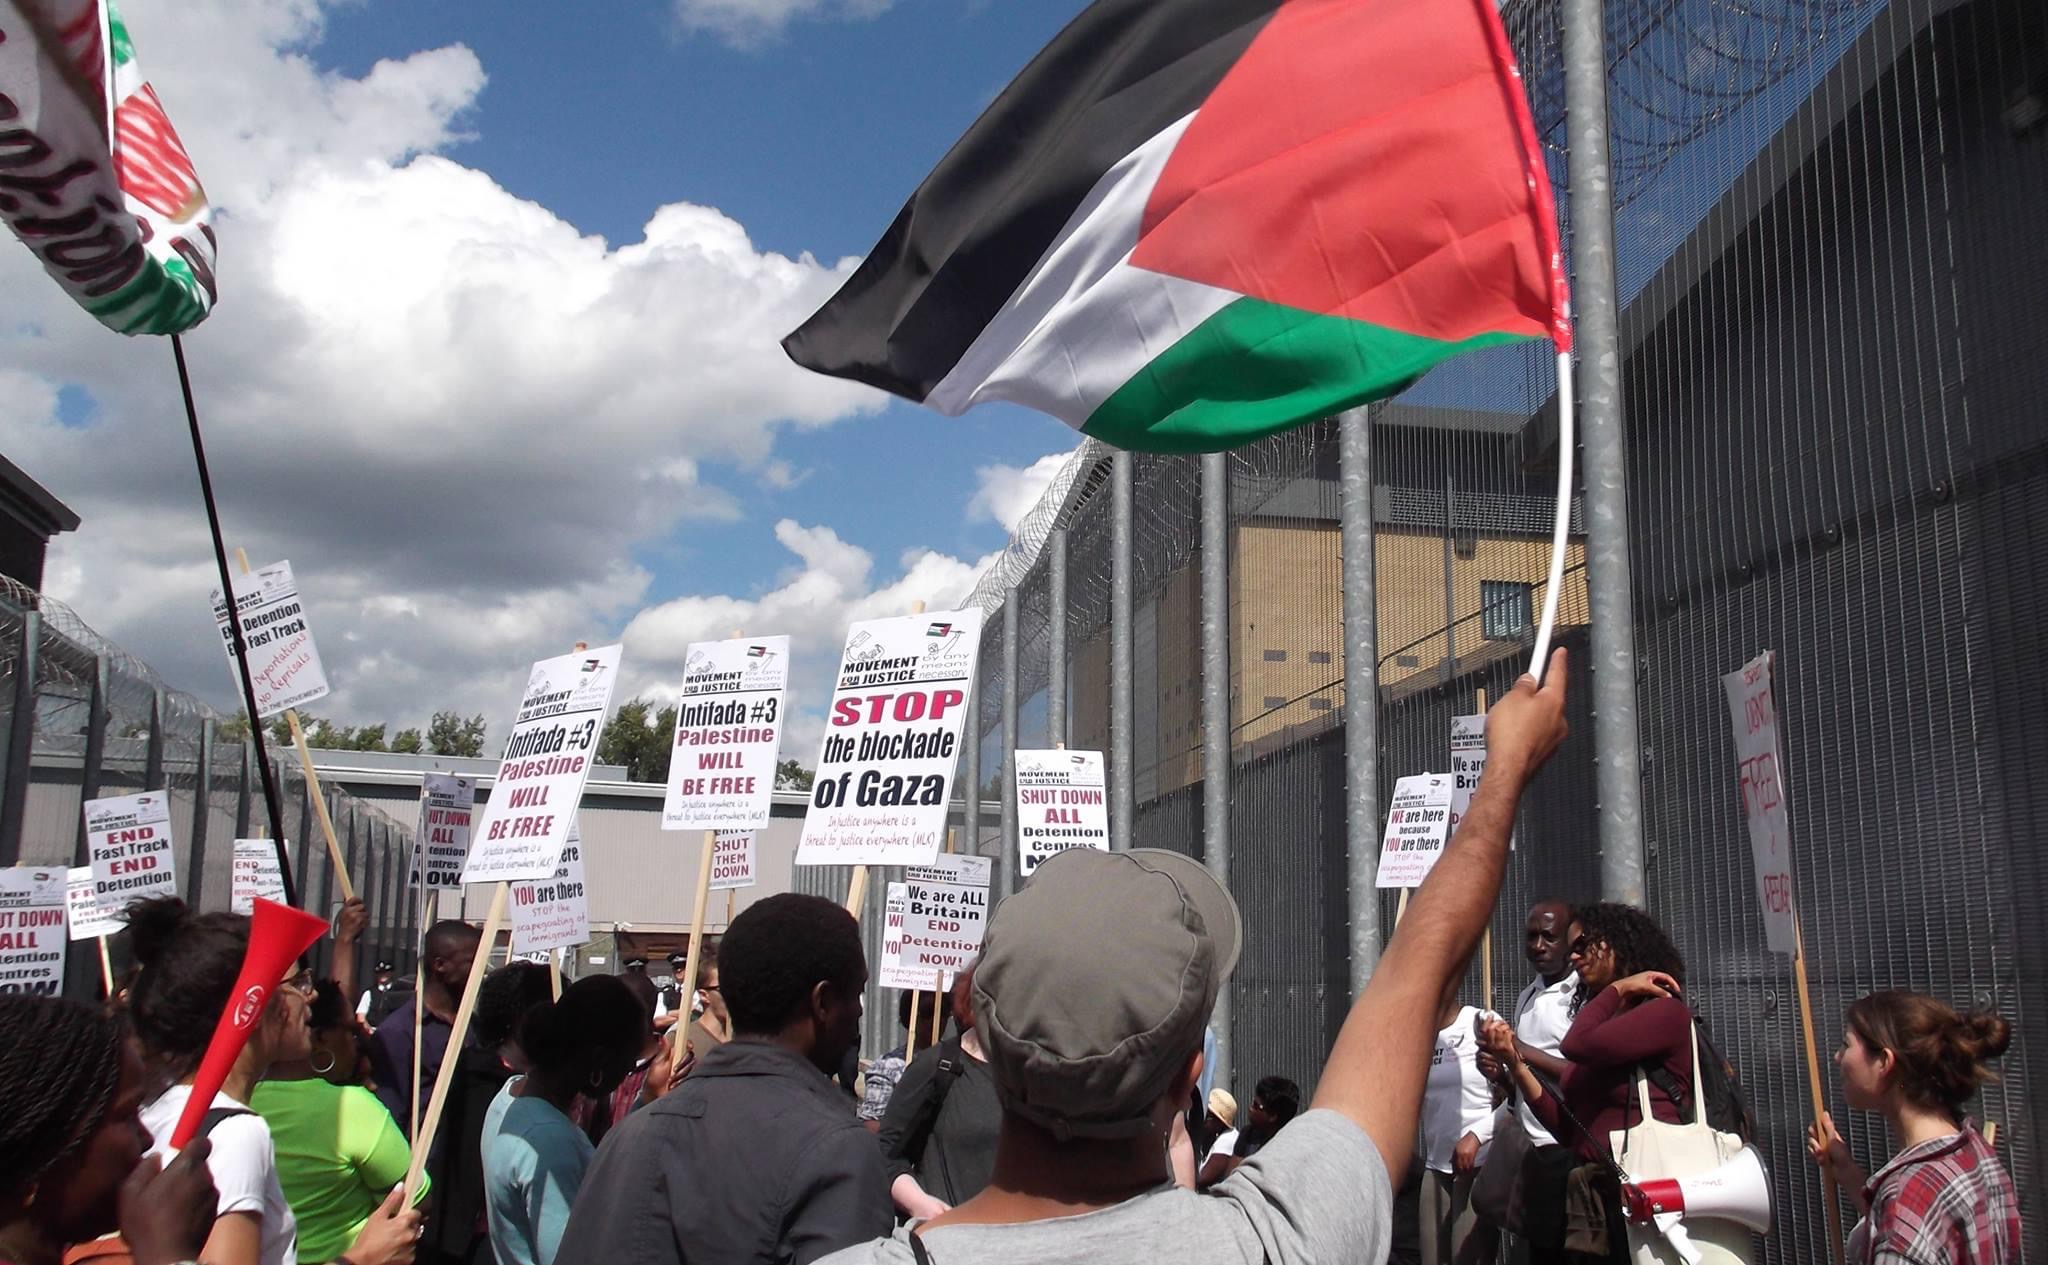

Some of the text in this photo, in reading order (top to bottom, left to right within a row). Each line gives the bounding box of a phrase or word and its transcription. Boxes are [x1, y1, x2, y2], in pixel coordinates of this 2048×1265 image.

[243, 602, 301, 632] Detention
[247, 619, 306, 649] Fast Track
[254, 633, 307, 685] Deportations
[844, 656, 919, 674] MOVEMENT
[921, 661, 968, 670] means
[685, 671, 743, 684] MOVEMENT
[862, 669, 916, 684] JUSTICE
[701, 681, 741, 692] JUSTICE
[523, 690, 572, 709] MOVEMENT
[832, 689, 964, 727] STOP
[532, 703, 569, 718] JUSTICE
[679, 696, 778, 728] Intifada #3
[506, 719, 595, 760] Intifada #3
[677, 726, 775, 747] Palestine
[823, 727, 954, 764] the blockade
[499, 754, 585, 782] Palestine
[698, 751, 744, 770] WILL
[1453, 756, 1467, 772] We
[681, 776, 756, 796] BE FREE
[814, 770, 945, 809] of Gaza
[508, 785, 550, 808] WILL
[1021, 789, 1102, 805] SHUT DOWN
[446, 811, 471, 826] DOWN
[863, 814, 898, 834] anywhere
[1045, 808, 1082, 824] ALL
[1391, 810, 1405, 825] WE
[1405, 811, 1420, 823] are
[1421, 808, 1444, 822] here
[107, 827, 153, 845] END
[431, 828, 454, 843] ALL
[488, 819, 510, 840] BE
[510, 815, 555, 838] FREE
[1023, 826, 1104, 837] Detention
[1399, 825, 1430, 835] because
[94, 838, 169, 860] Fast Track
[714, 838, 750, 852] SHUT
[866, 836, 909, 853] everywhere
[1385, 835, 1440, 852] YOU are there
[559, 846, 579, 862] ere
[715, 853, 746, 865] THEM
[110, 855, 156, 875] END
[235, 861, 258, 869] END
[714, 864, 749, 879] DOWN
[907, 866, 958, 876] MOVEMENT
[97, 871, 171, 894] Detention
[922, 874, 958, 882] JUSTICE
[513, 881, 583, 906] YOU are there
[908, 885, 985, 906] We are ALL
[18, 909, 63, 927] DOWN
[532, 904, 570, 917] STOP the
[911, 901, 980, 920] Britain
[928, 919, 960, 932] END
[0, 932, 38, 949] ALL
[0, 951, 59, 965] tention
[919, 953, 962, 968] NOW!
[0, 967, 51, 980] entres
[0, 980, 58, 996] OW
